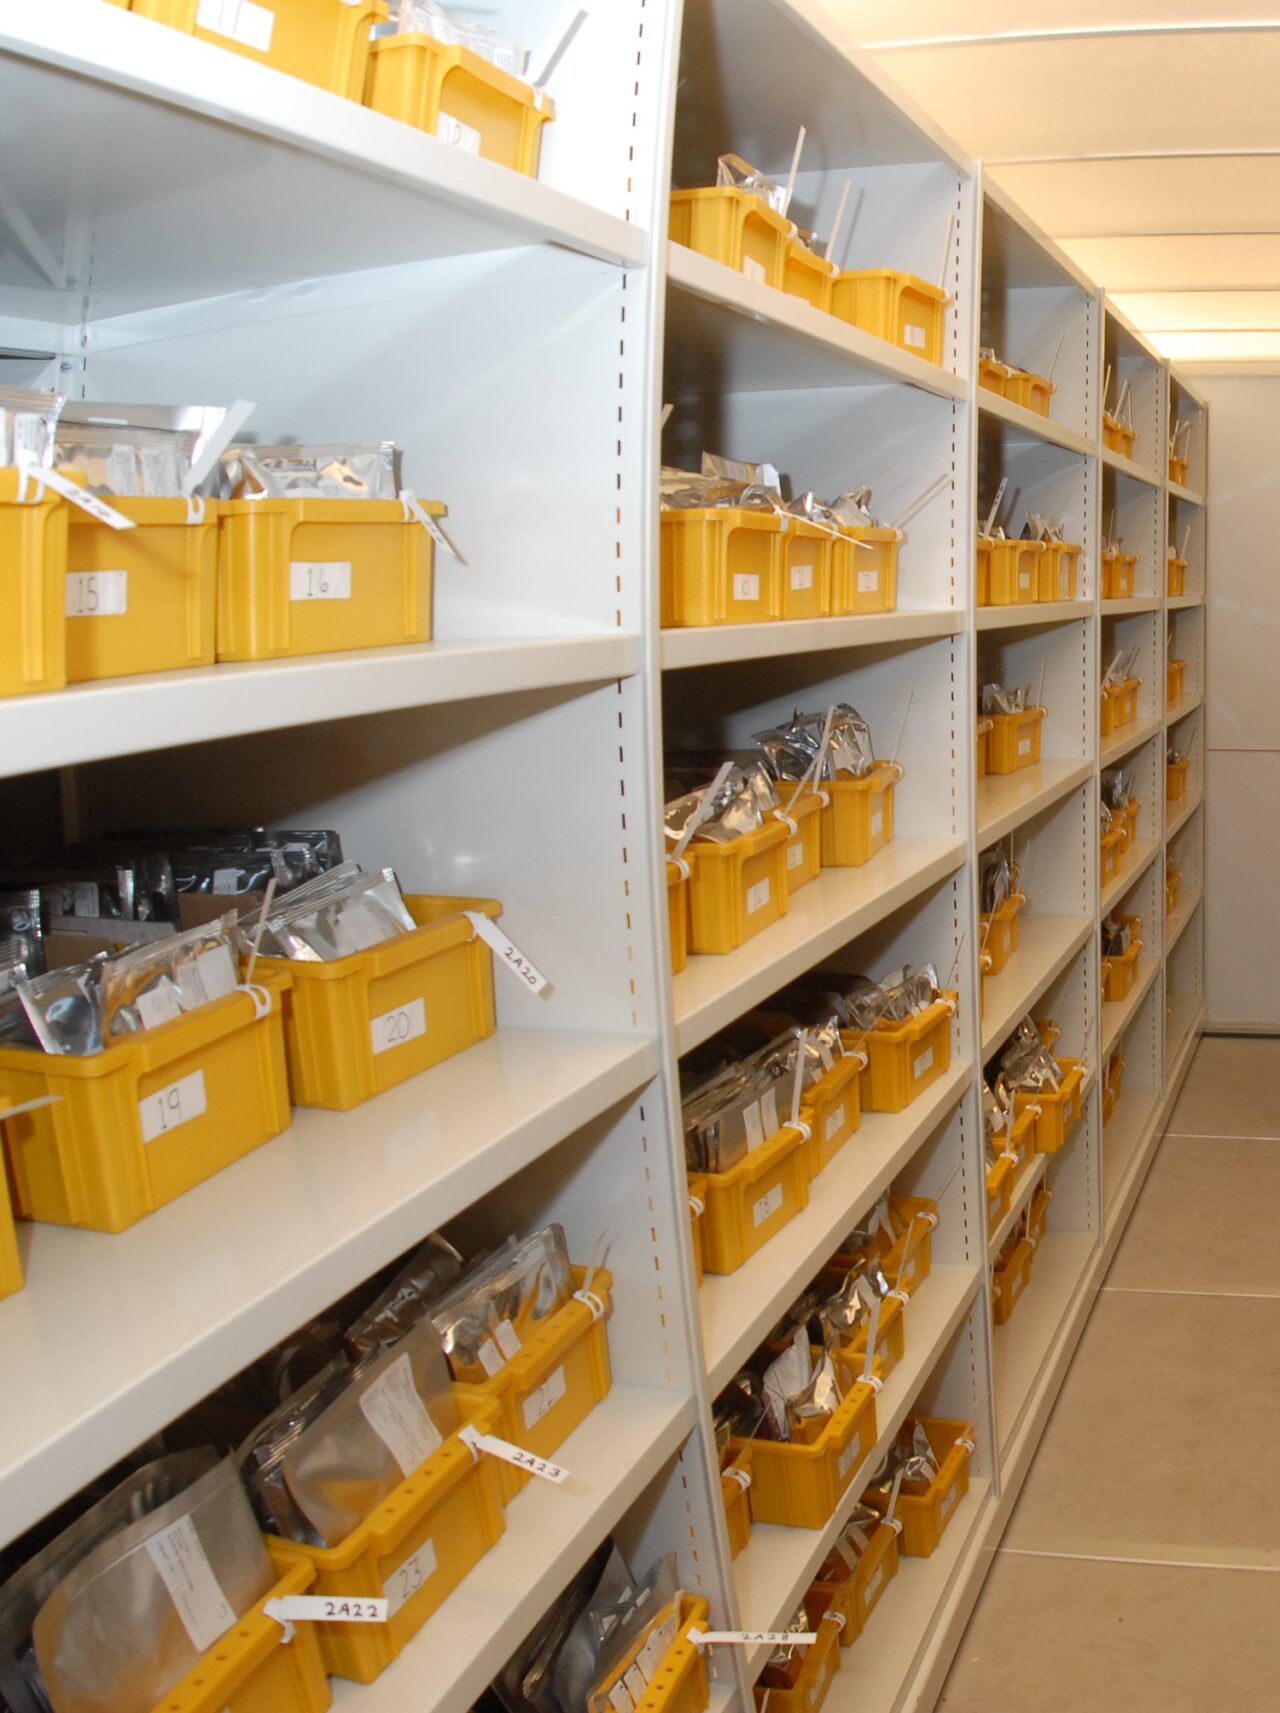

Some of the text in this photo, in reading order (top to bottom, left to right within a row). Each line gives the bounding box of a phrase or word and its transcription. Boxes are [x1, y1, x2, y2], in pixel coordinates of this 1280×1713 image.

[77, 576, 99, 614] 15
[306, 567, 329, 598] 16
[505, 946, 538, 985] 2A20
[386, 1010, 411, 1044] 20
[157, 1087, 184, 1130] 19
[513, 1451, 562, 1479] 2A23
[399, 1556, 424, 1599] 23
[324, 1602, 379, 1618] 2A22
